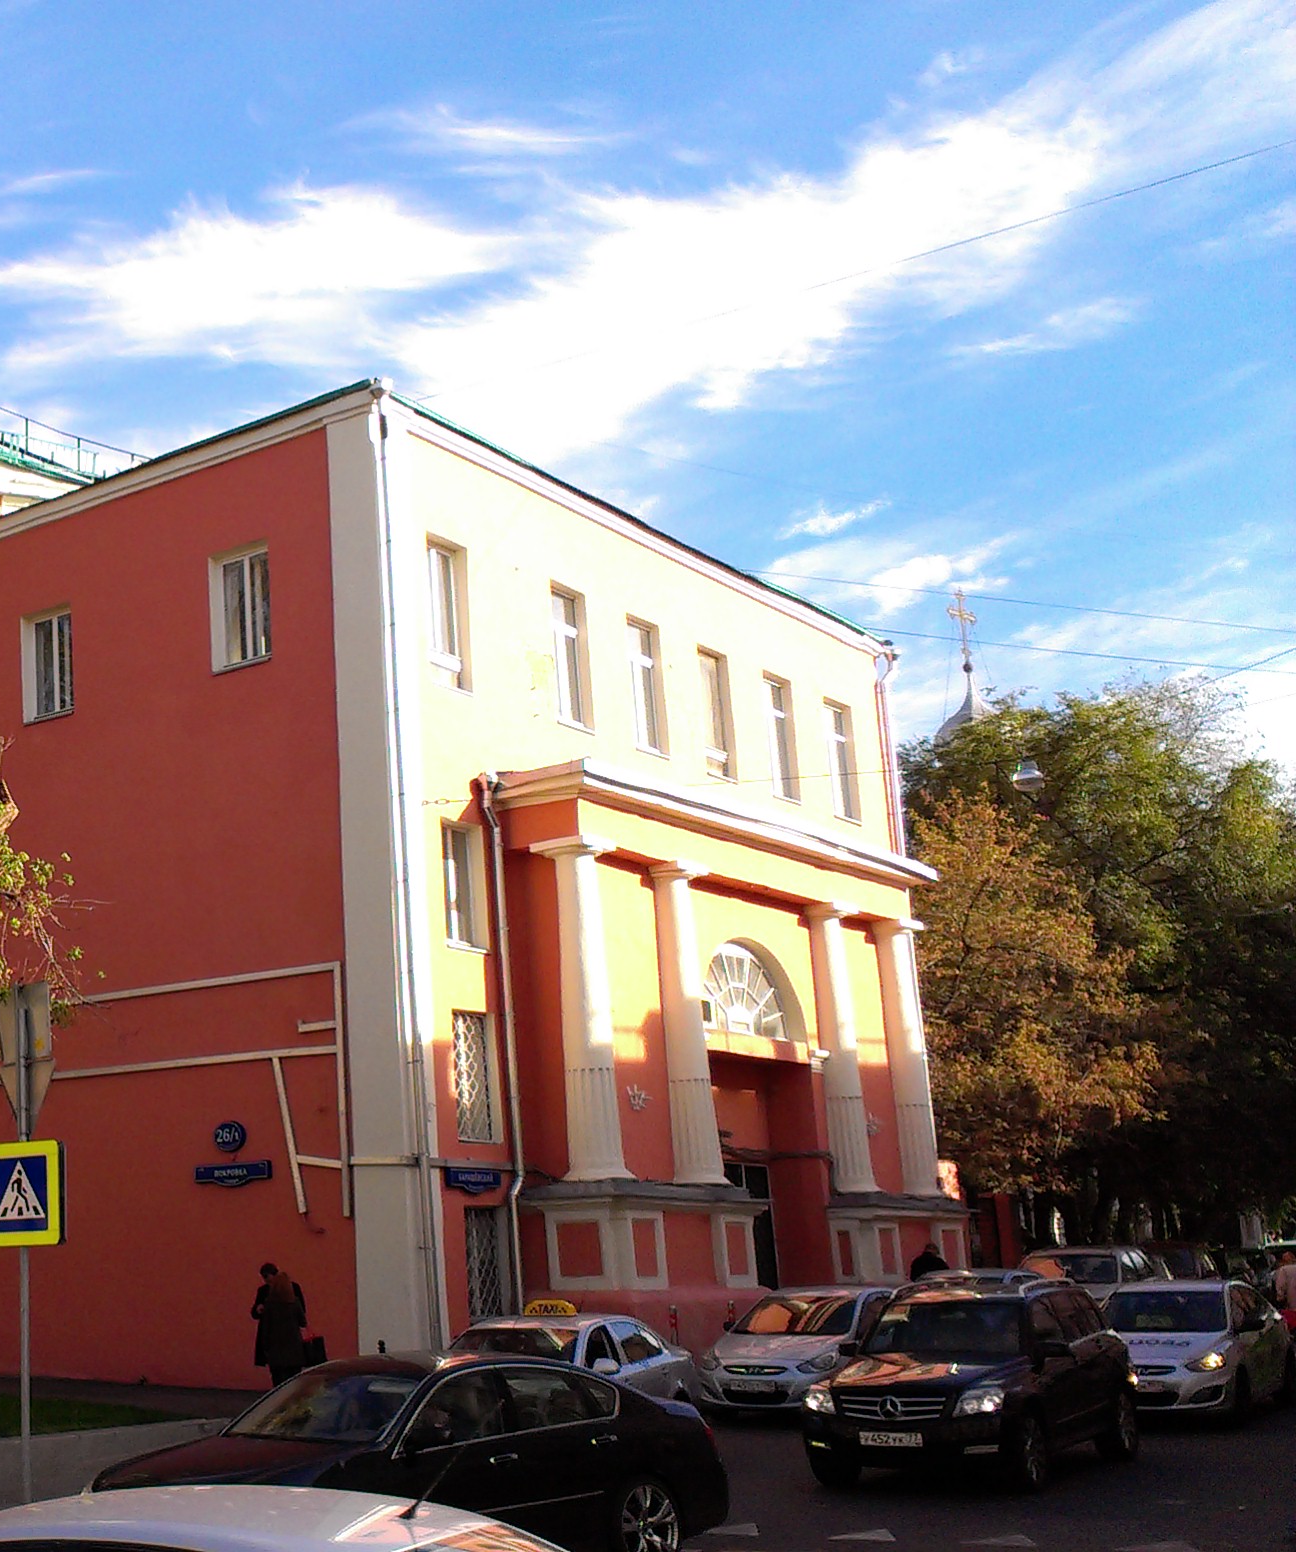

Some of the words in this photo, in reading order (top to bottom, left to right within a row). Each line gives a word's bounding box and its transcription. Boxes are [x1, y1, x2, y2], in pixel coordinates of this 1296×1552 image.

[216, 1127, 239, 1142] 26/1
[213, 1168, 248, 1178] ПОКРОВКА
[538, 1304, 557, 1314] TAXI
